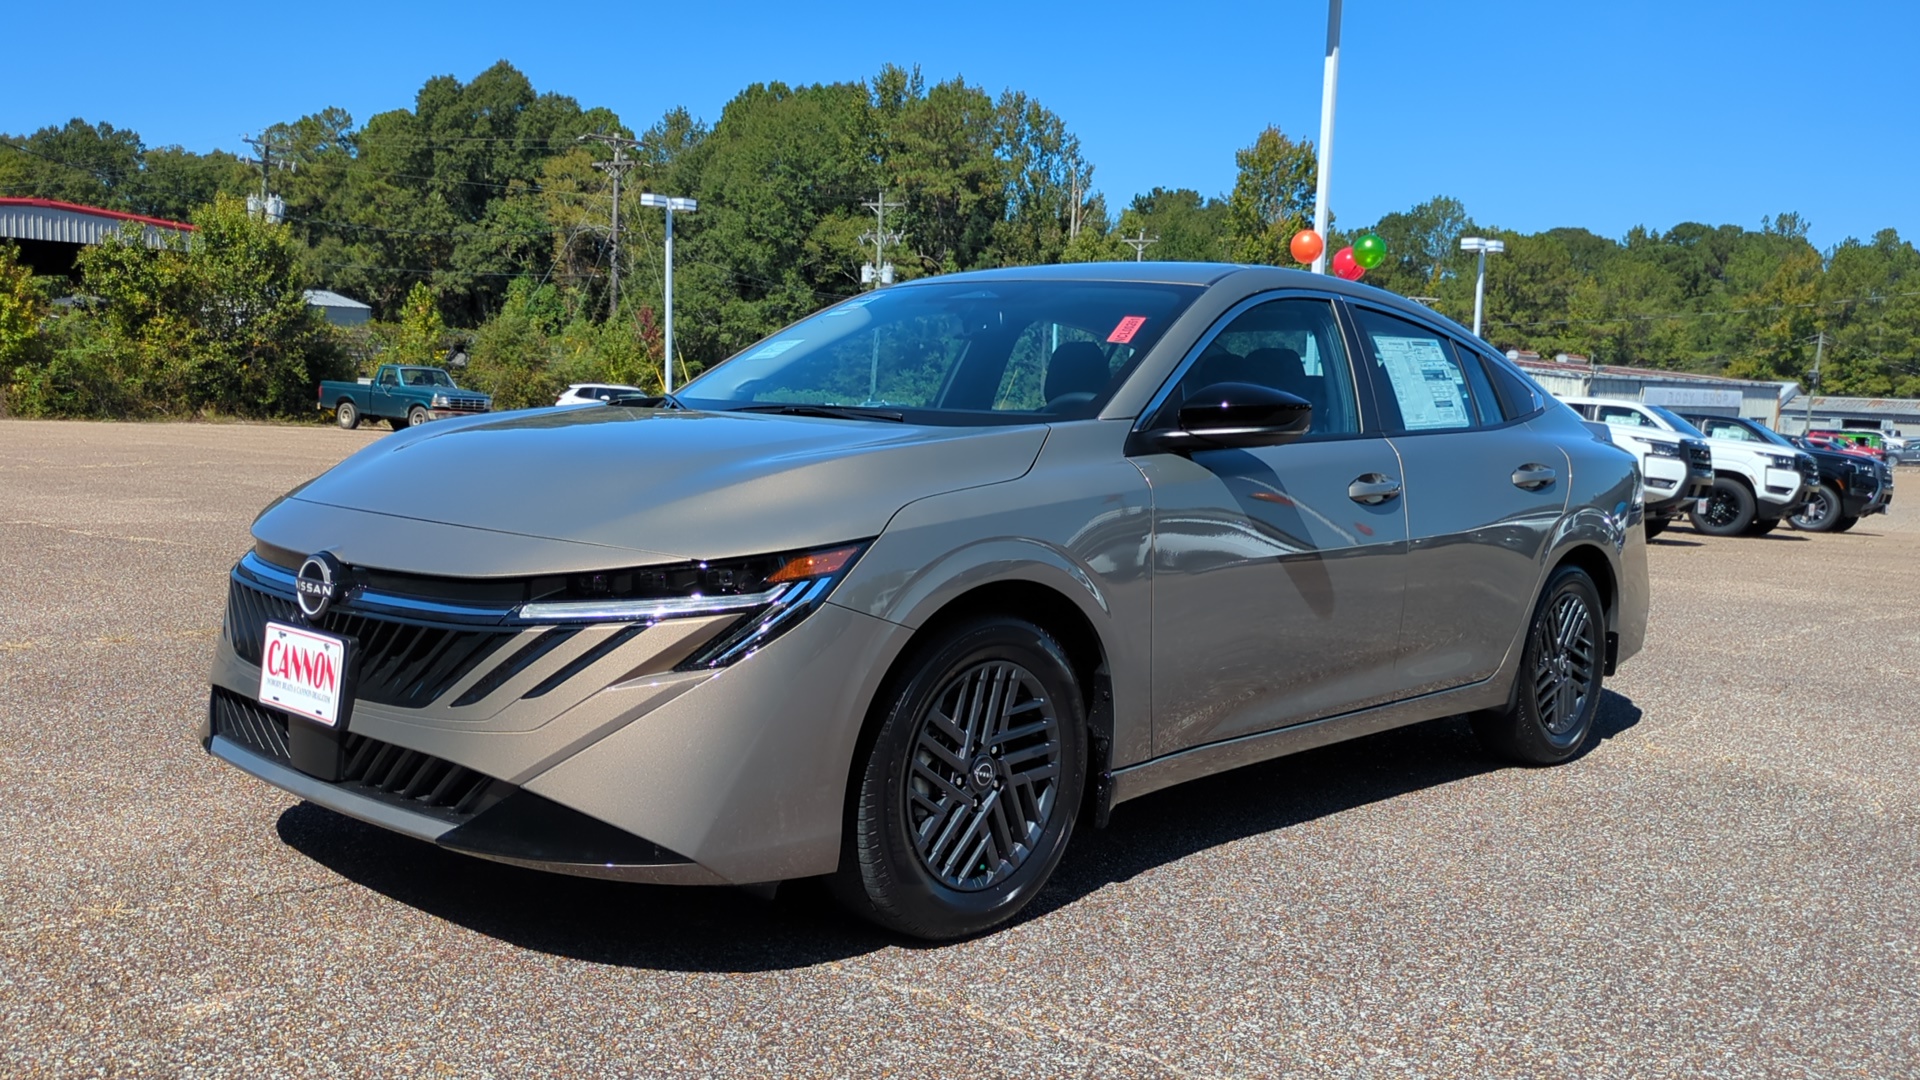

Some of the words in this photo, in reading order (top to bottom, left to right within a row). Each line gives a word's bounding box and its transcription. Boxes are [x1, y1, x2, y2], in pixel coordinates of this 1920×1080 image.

[1667, 391, 1696, 404] BODY
[1702, 392, 1729, 405] SHOP
[296, 579, 332, 596] NISSAN
[267, 639, 337, 694] CANNON
